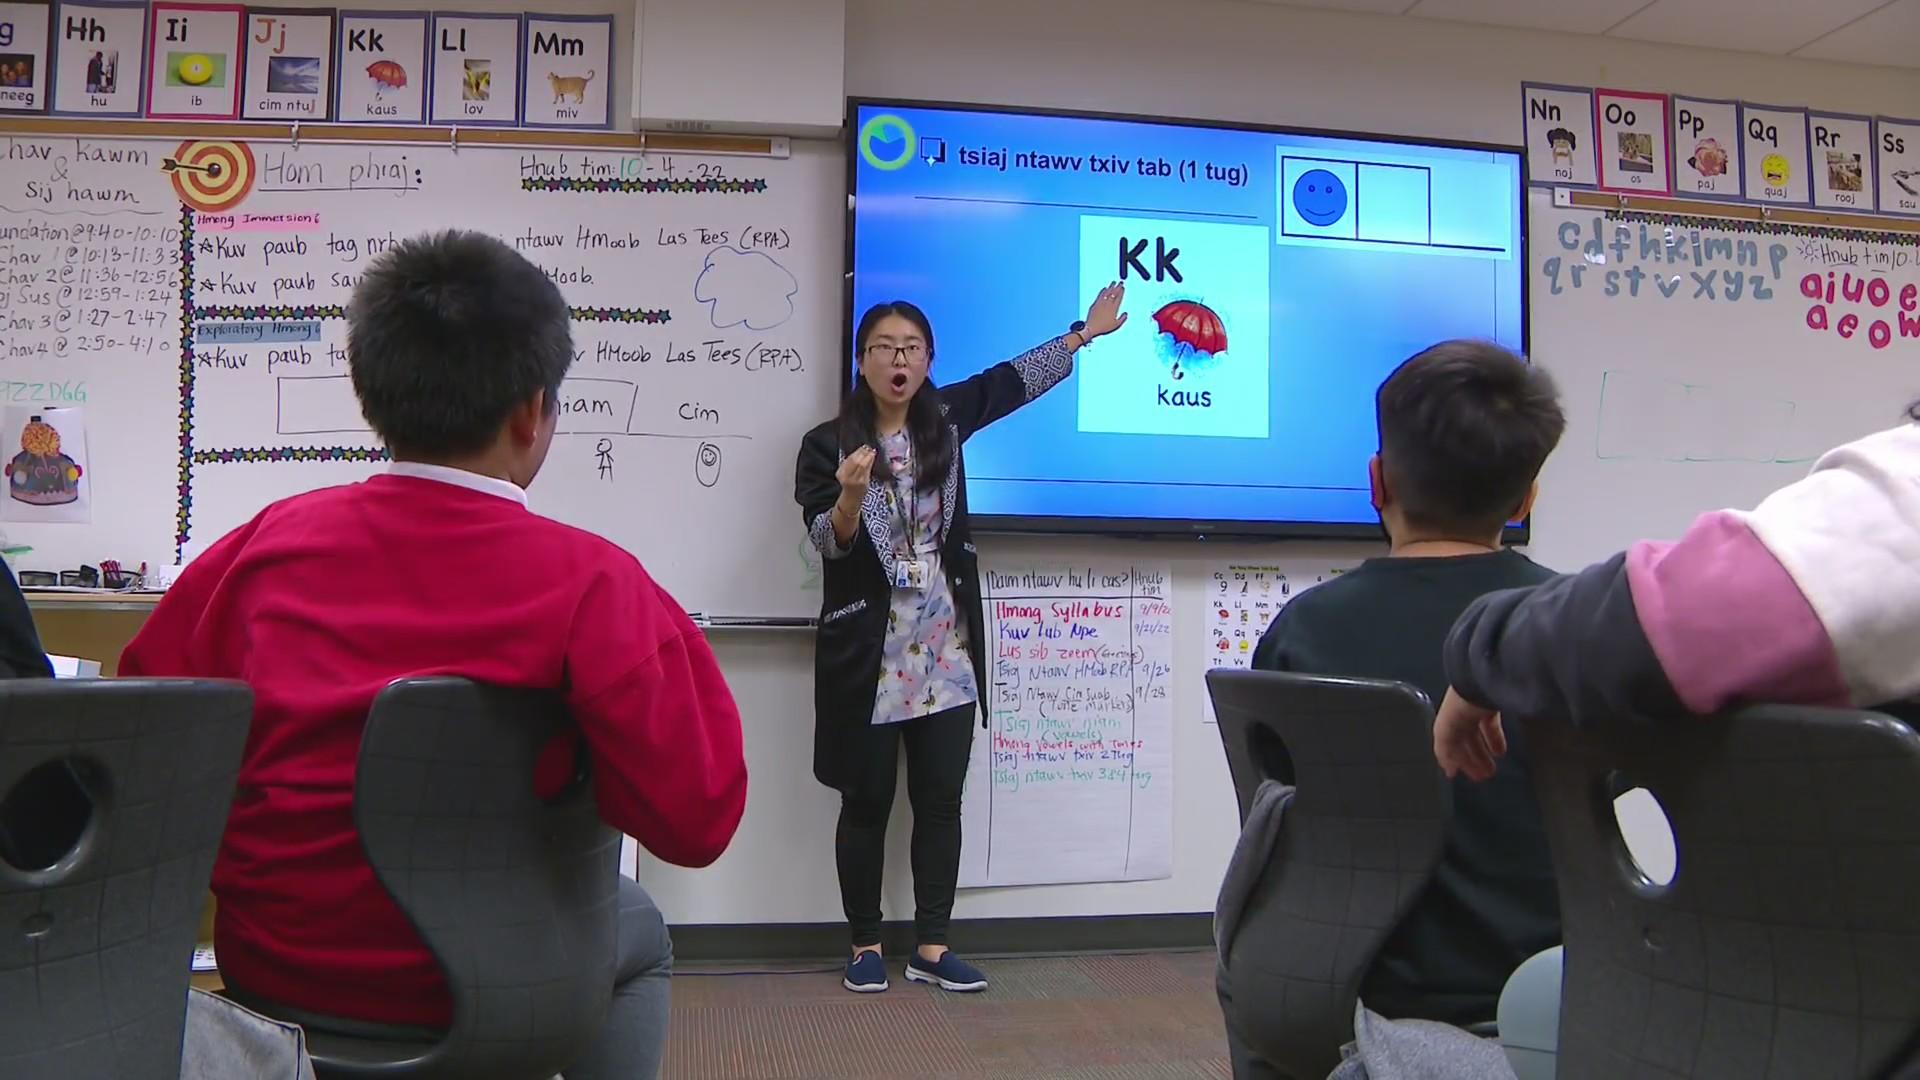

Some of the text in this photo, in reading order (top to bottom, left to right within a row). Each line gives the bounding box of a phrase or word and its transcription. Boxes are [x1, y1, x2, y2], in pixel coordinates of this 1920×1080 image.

[66, 16, 105, 42] Hh
[166, 18, 188, 42] Ii
[255, 18, 286, 54] Jj
[349, 28, 384, 52] Kk
[441, 28, 466, 52] Ll
[533, 31, 584, 56] Mm
[1, 91, 34, 105] neeg
[90, 96, 107, 107] hu
[191, 95, 202, 106] ib
[259, 99, 282, 111] cim
[367, 103, 397, 116] kaus
[464, 102, 484, 115] lov
[556, 107, 579, 119] miv
[1531, 98, 1561, 122] Nn
[1605, 103, 1636, 126] Oo
[1679, 110, 1705, 139] Pp
[1748, 118, 1778, 148] Qq
[1815, 126, 1841, 147] Rr
[1883, 133, 1905, 154] Ss
[0, 137, 51, 161] hav
[51, 156, 68, 182] &
[520, 154, 568, 177] Hnub
[959, 147, 1249, 186] tsiaj ntawv txiv tab (1 tug)
[1555, 169, 1573, 180] noj
[1631, 175, 1641, 184] os
[1698, 180, 1715, 191] paj
[25, 181, 140, 204] Sij hawm
[1765, 187, 1788, 199] quaj
[1835, 193, 1855, 204] rooj
[1899, 200, 1916, 209] sau
[197, 215, 235, 230] Hmong
[264, 235, 307, 266] paub
[327, 232, 358, 262] tag
[516, 227, 564, 248] ntawv
[657, 228, 687, 245] Las
[1119, 236, 1183, 283] Kk
[1820, 243, 1858, 264] Hnub
[273, 272, 316, 299] paub
[268, 345, 311, 373] paub
[665, 342, 696, 363] Las
[702, 340, 741, 365] Tees
[1158, 384, 1211, 407] kaus
[996, 601, 1123, 625] Hmong Syllabus
[1000, 620, 1030, 640] Kuv
[1000, 642, 1021, 659] Lus
